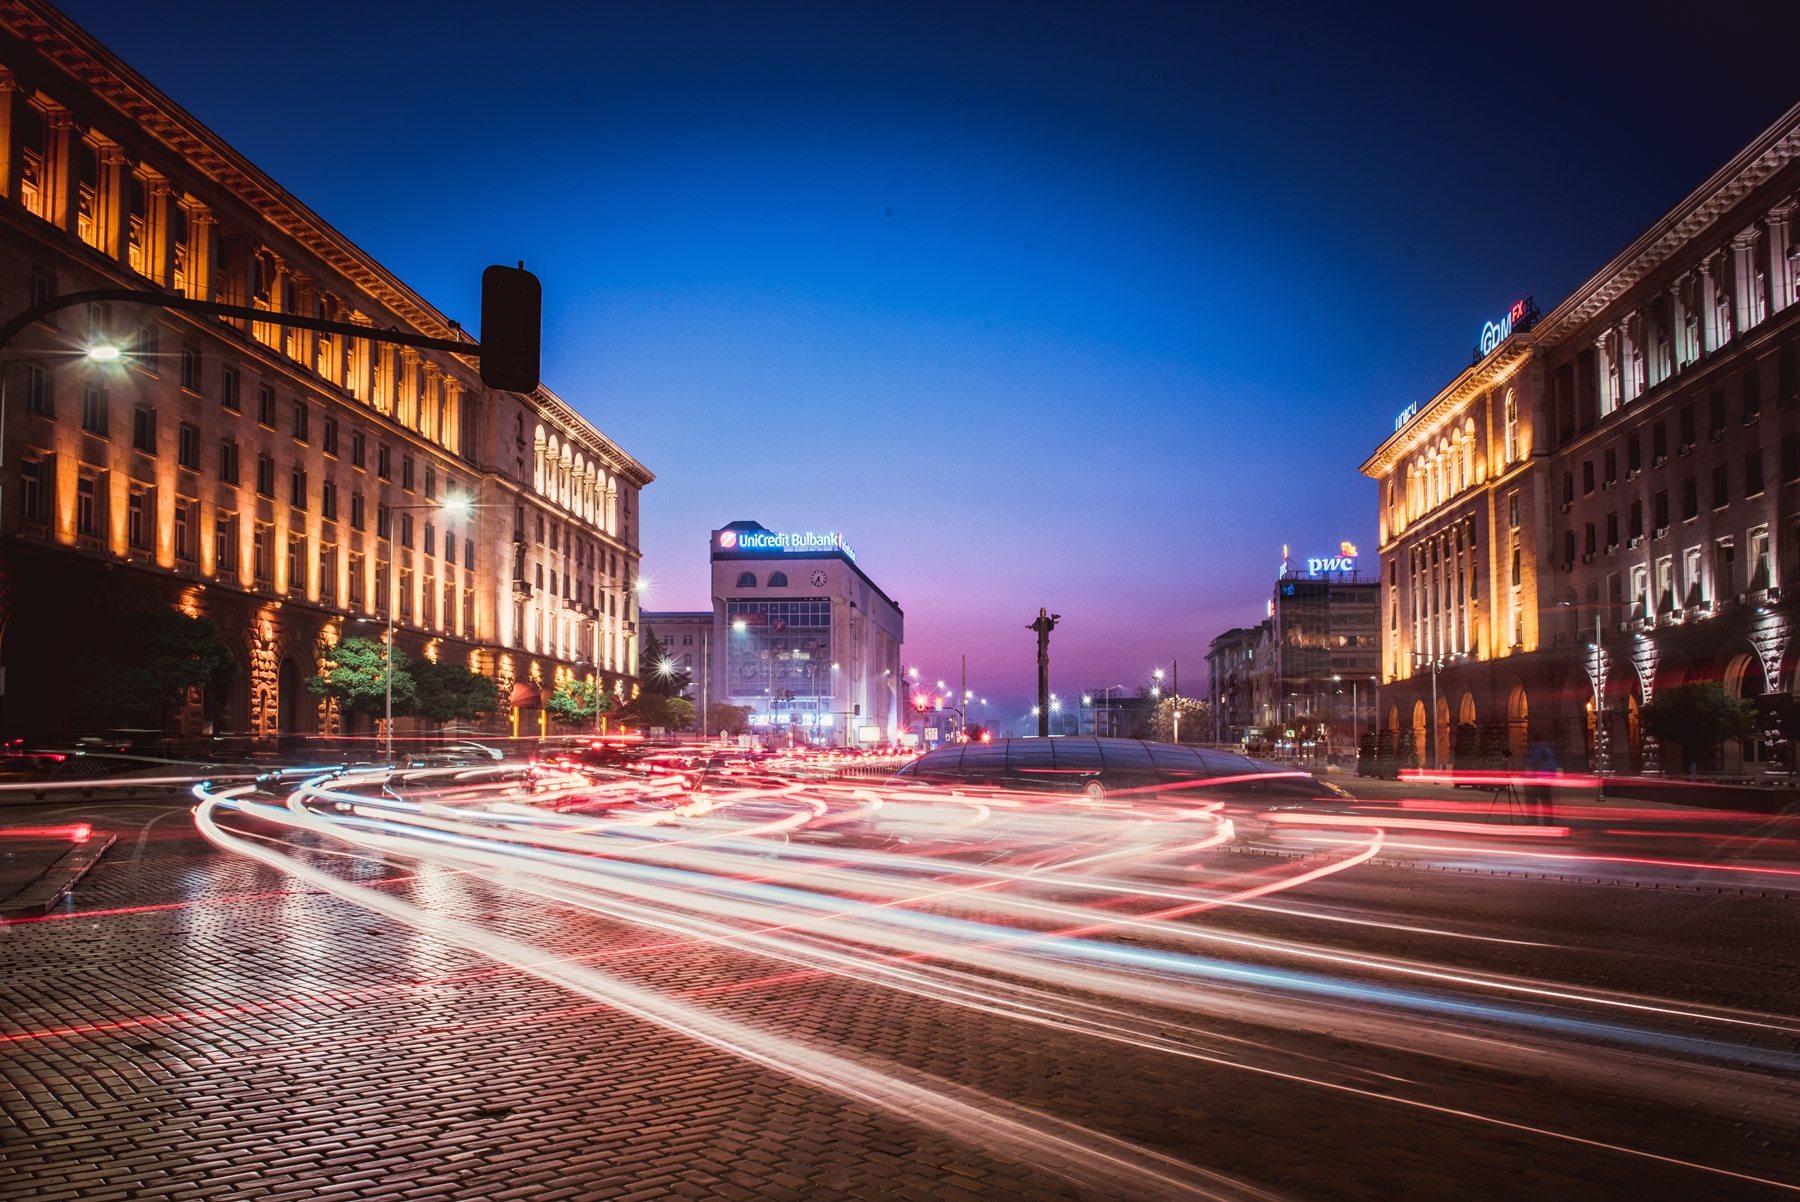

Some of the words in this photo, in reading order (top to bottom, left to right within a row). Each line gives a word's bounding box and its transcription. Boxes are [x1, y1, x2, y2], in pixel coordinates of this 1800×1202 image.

[740, 533, 789, 547] UniCredit
[792, 532, 838, 546] Bulbank
[1308, 558, 1353, 575] pwc
